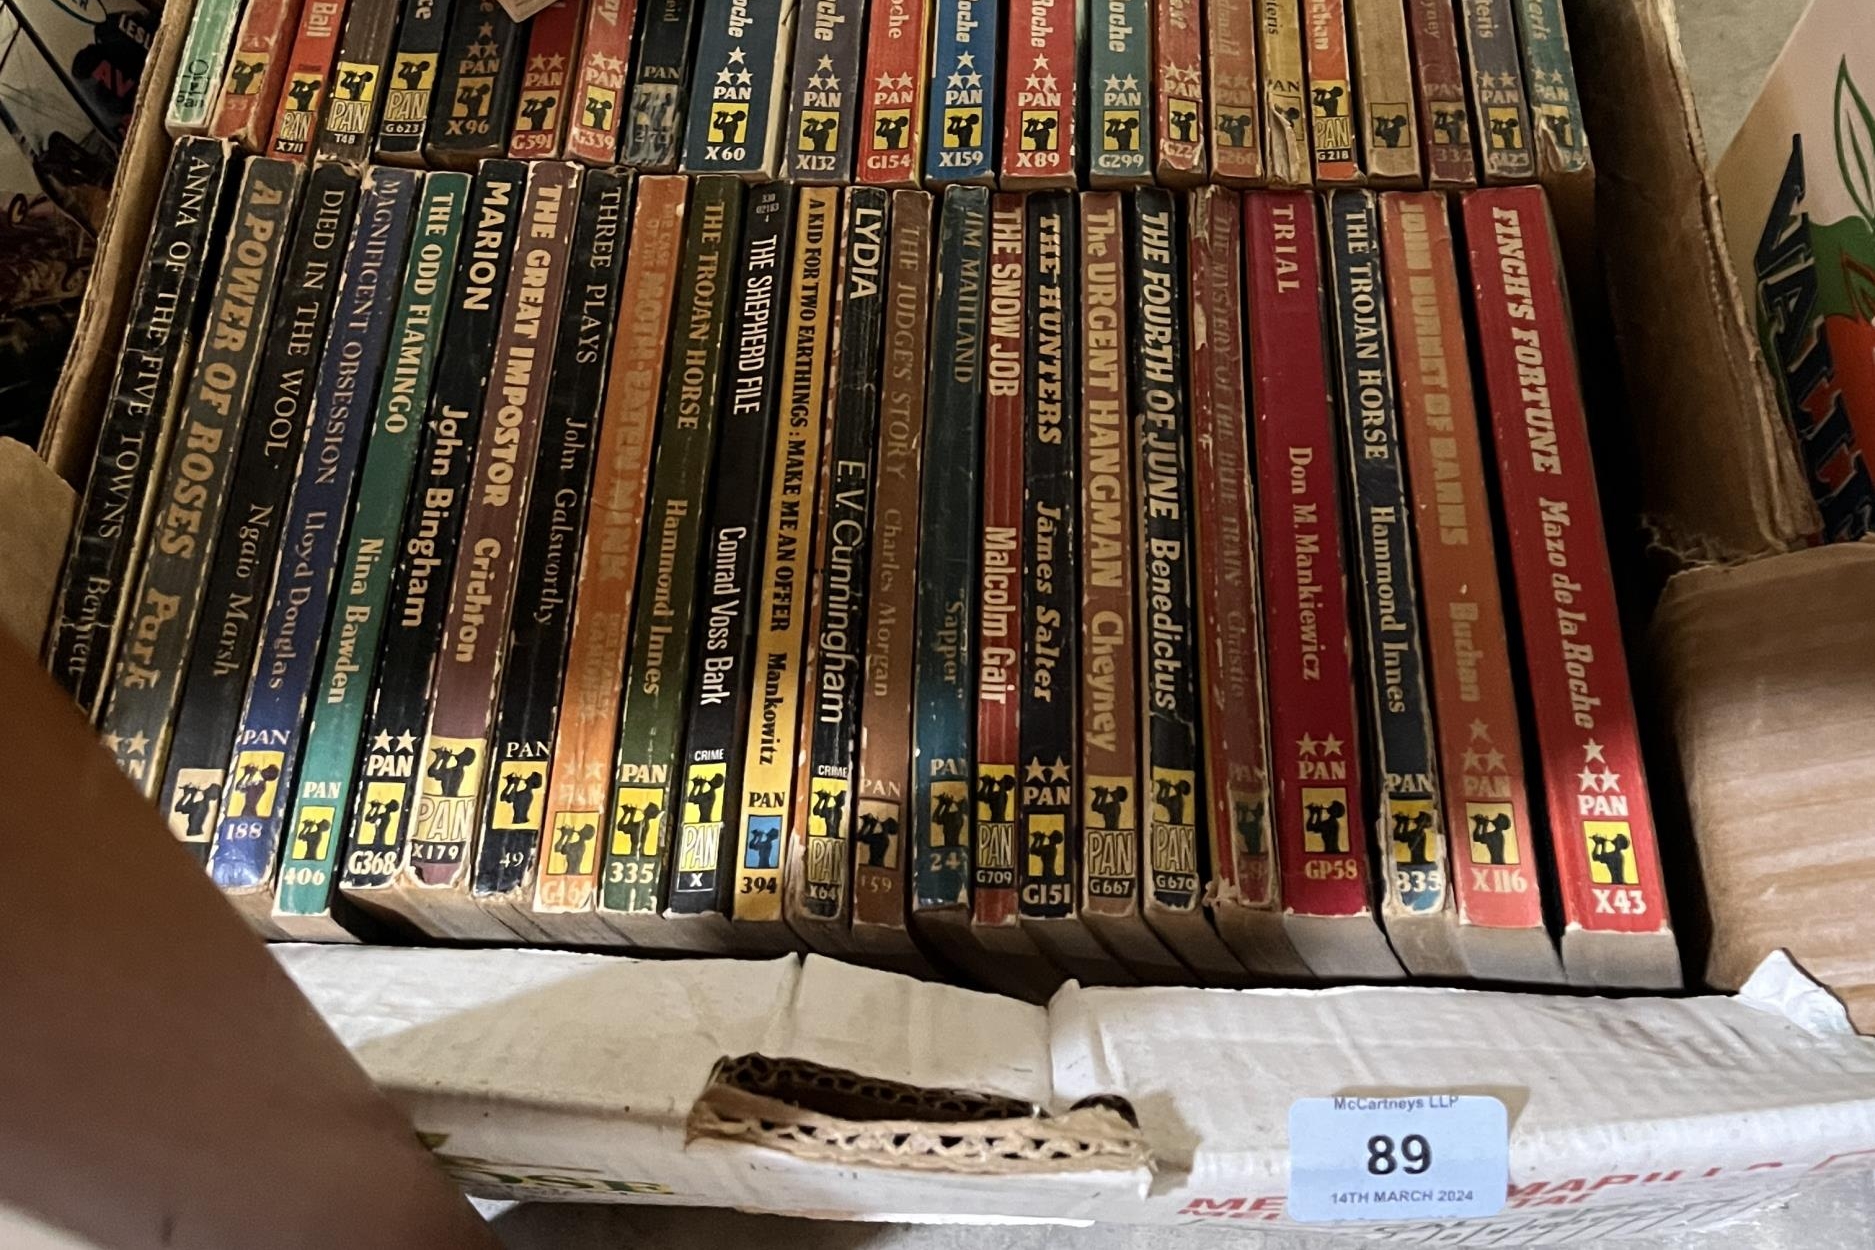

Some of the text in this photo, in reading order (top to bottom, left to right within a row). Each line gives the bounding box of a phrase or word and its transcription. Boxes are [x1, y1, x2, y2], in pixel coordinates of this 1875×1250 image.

[306, 0, 338, 38] Ball
[526, 72, 564, 87] PAN
[945, 89, 983, 105] PAN
[1104, 92, 1141, 106] PAN
[511, 134, 553, 150] G591
[939, 152, 984, 167] X159
[1100, 155, 1144, 167] G299
[100, 156, 209, 539] ANNA OF THE FIVE TOWNS
[401, 181, 512, 628] MARION John Bingham
[122, 179, 282, 690] A POWER OF ROSES Park
[455, 184, 562, 662] THE GREAT IMPOSTOR Crichton
[328, 192, 454, 703] THE ODD FLAMINGO Nina Bawden
[1272, 204, 1326, 681] TRIAL Don M. Mankiewicz
[819, 207, 882, 724] LYDIA Cunningham
[981, 208, 1022, 705] THE SNOW JOB Malcolm Gair
[1034, 214, 1062, 702] THE HUNTERS James Salter
[1493, 207, 1600, 729] FINCH'S FORTUNE Mazo de la Roche
[700, 235, 777, 706] THE SHEPHERD FILE Conrad Voss Bark
[759, 198, 825, 765] A KID FOR TWO FARTHINGS MAKE ME AN OFFER Mankowitz
[1086, 209, 1124, 751] The URGENT HANGMAN Cheyney
[366, 754, 413, 777] PAN
[1299, 761, 1346, 780] PAN
[303, 781, 342, 799] PAN
[749, 791, 785, 808] PAN
[1578, 795, 1628, 816] PAN
[978, 823, 1013, 868] PAN
[283, 868, 326, 886] 406
[976, 870, 1012, 884] G709
[1305, 860, 1358, 880] GP58
[741, 876, 777, 894] 394
[1592, 889, 1647, 914] X43
[1334, 1095, 1459, 1112] McCartneys LLP
[1367, 1134, 1432, 1175] 89
[1331, 1190, 1473, 1204] 14TH MARCH 2024
